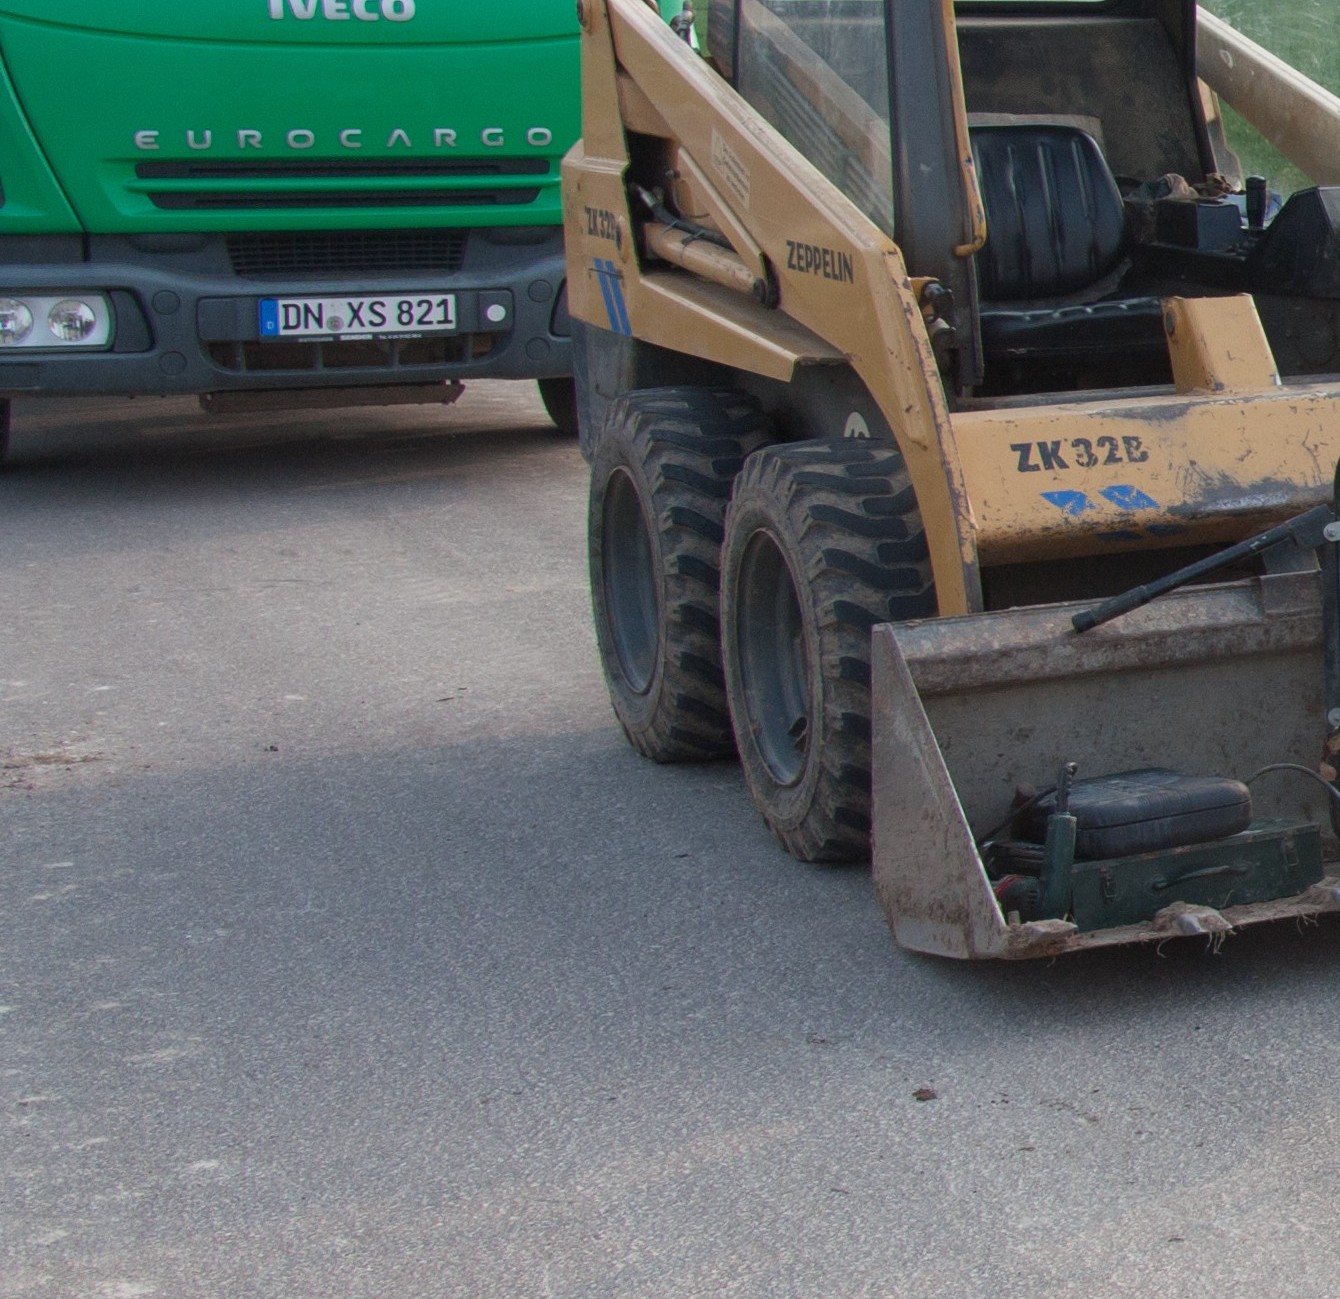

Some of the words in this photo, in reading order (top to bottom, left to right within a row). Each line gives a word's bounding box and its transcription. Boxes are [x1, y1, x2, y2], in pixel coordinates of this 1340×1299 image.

[268, 0, 416, 21] IVECO
[133, 127, 553, 149] EUROCARGO
[786, 239, 854, 285] ZEPPELIN
[282, 302, 324, 330] DN
[347, 300, 388, 328] XS
[397, 298, 454, 326] 821
[1009, 439, 1070, 473] ZK
[1071, 435, 1149, 468] 32B
